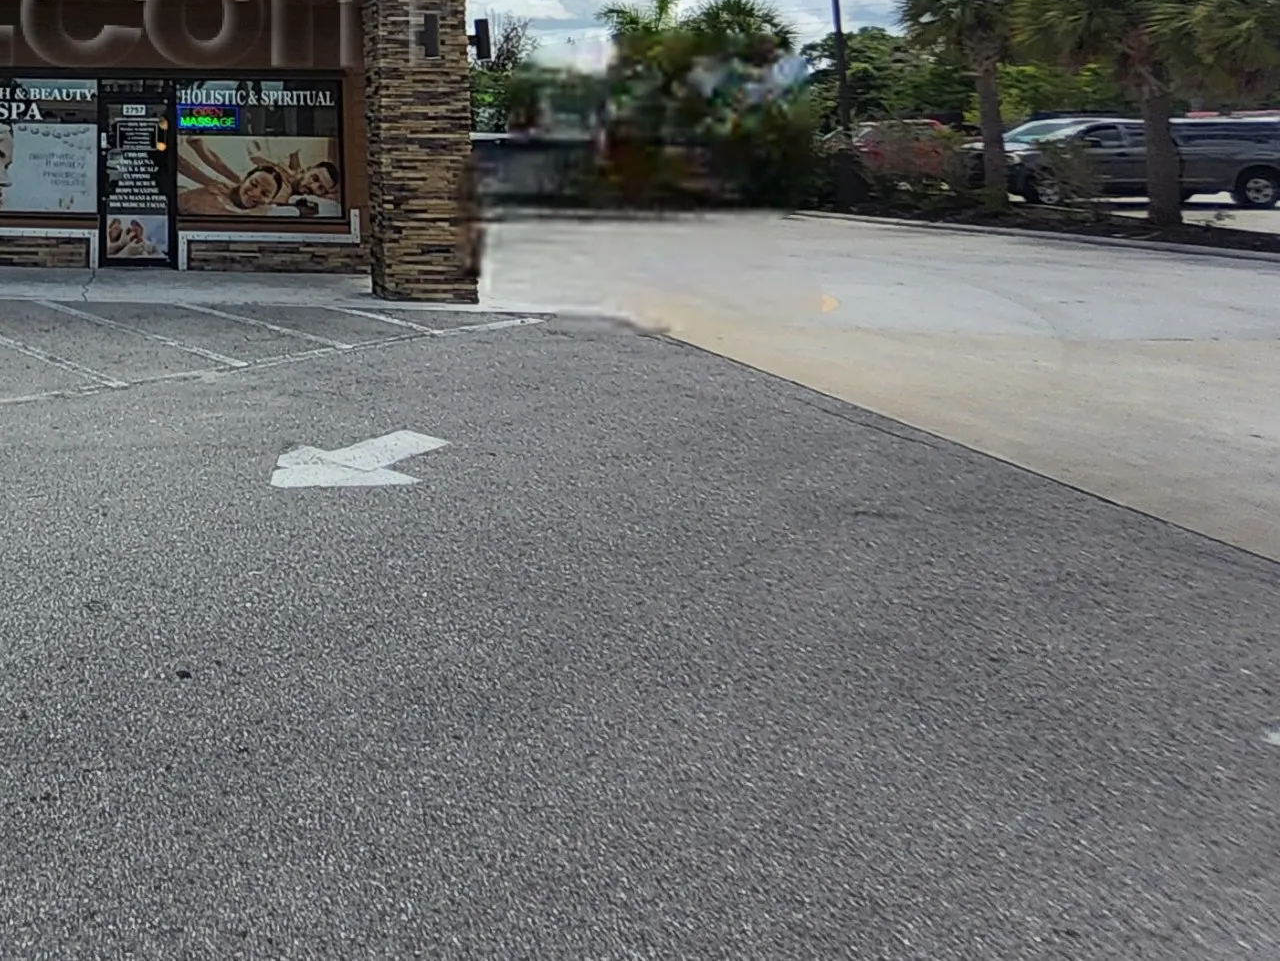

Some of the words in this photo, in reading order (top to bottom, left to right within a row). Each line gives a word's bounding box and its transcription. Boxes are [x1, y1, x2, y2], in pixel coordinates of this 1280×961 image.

[14, 87, 28, 101] &
[29, 88, 95, 102] BEAUTY
[180, 89, 246, 106] HOLISTIC
[248, 90, 259, 106] &
[261, 90, 335, 107] SPIRITUAL
[180, 117, 236, 127] MASSAGE
